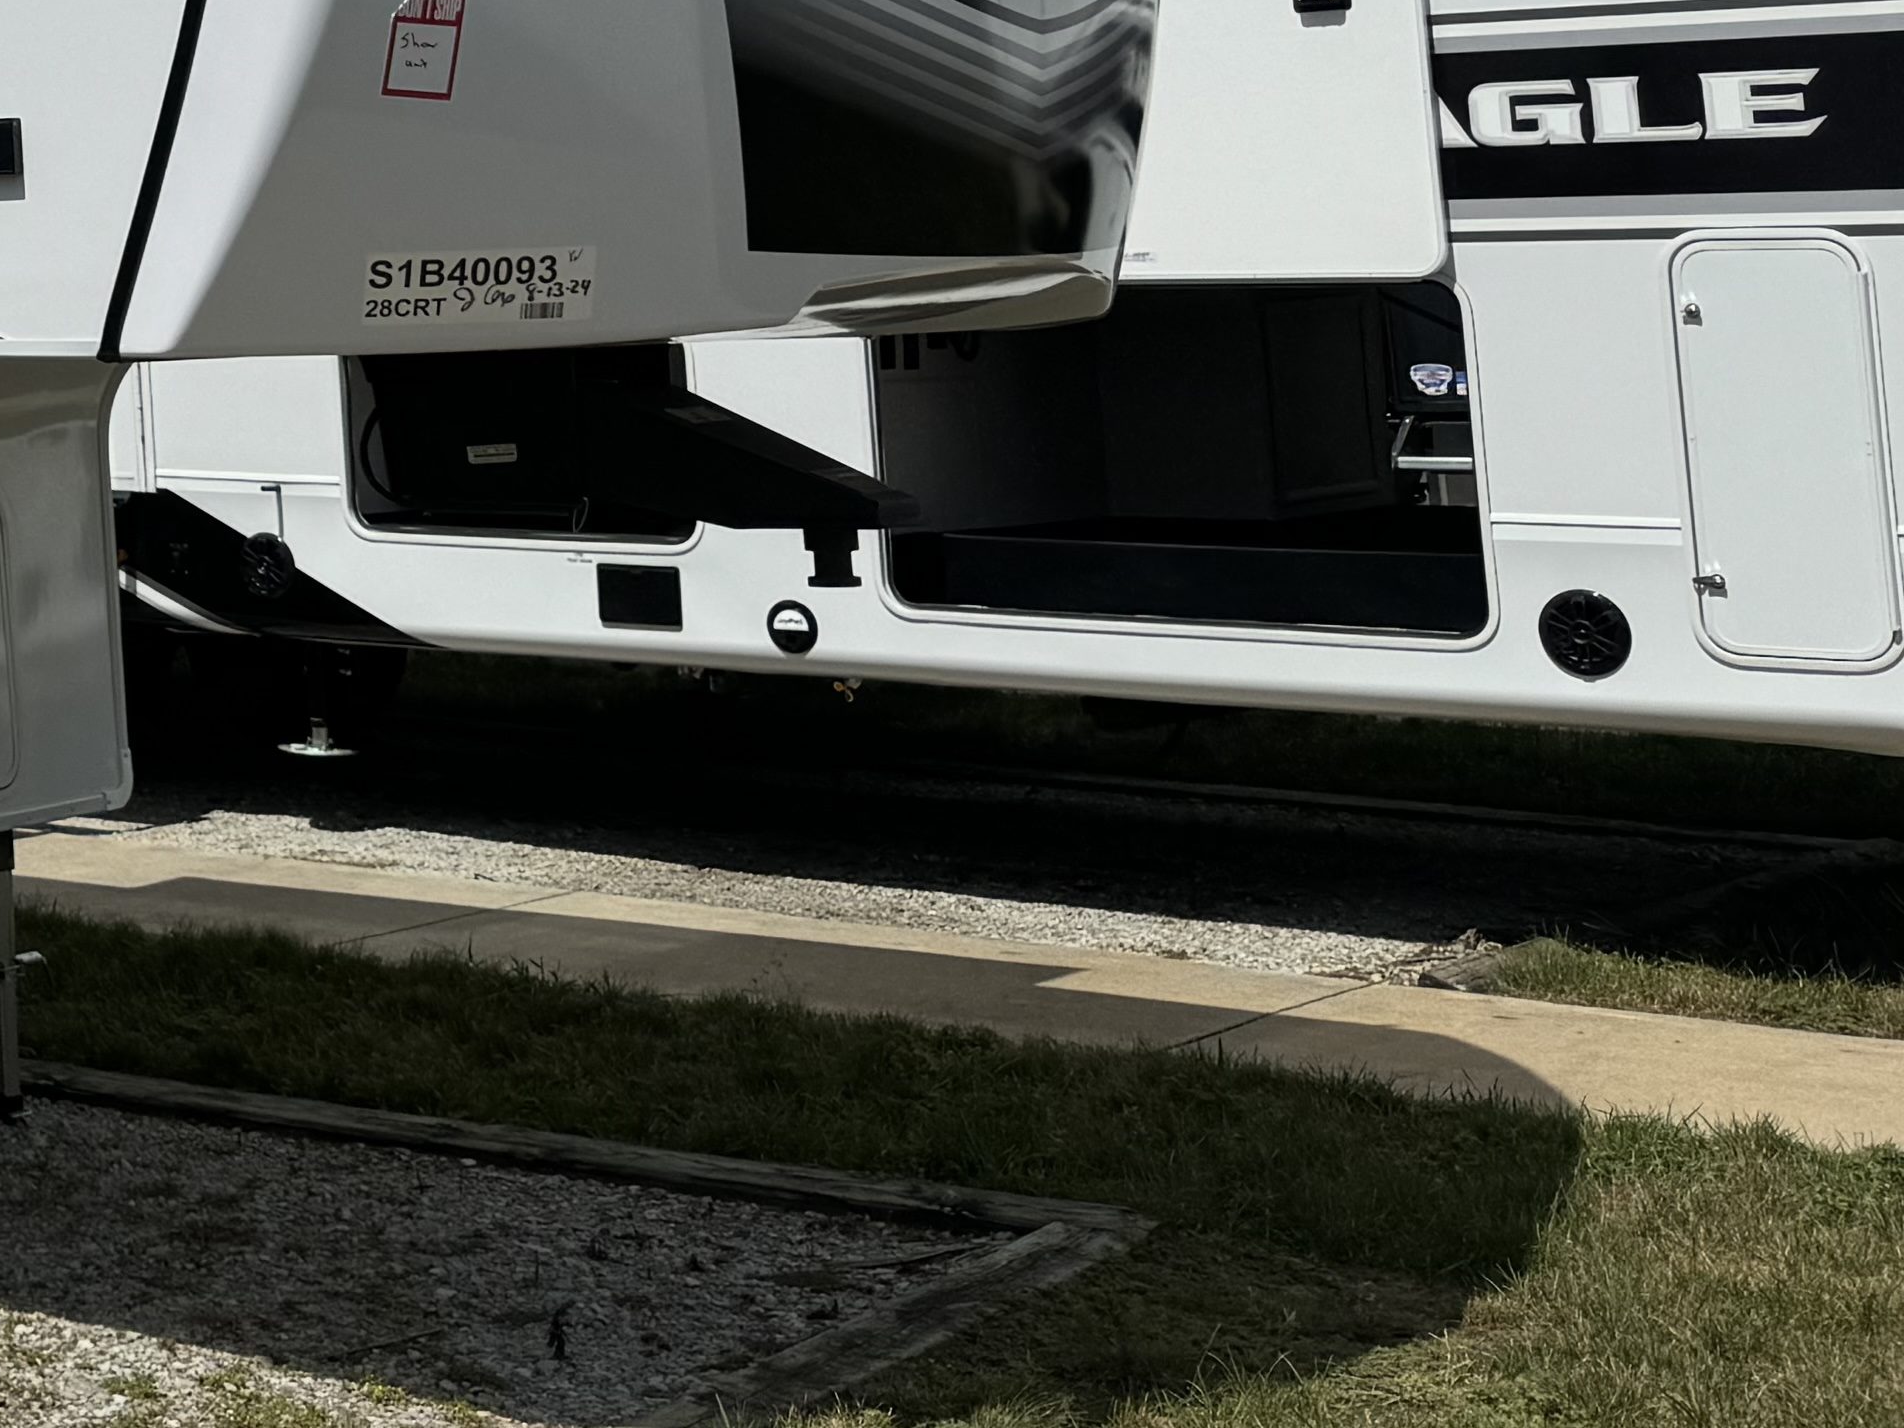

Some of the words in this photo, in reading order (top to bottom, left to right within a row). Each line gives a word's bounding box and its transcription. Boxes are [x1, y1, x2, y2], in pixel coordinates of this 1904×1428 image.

[368, 255, 558, 289] S1B40093
[525, 278, 591, 302] 8-13-24
[364, 298, 447, 318] 28CRT
